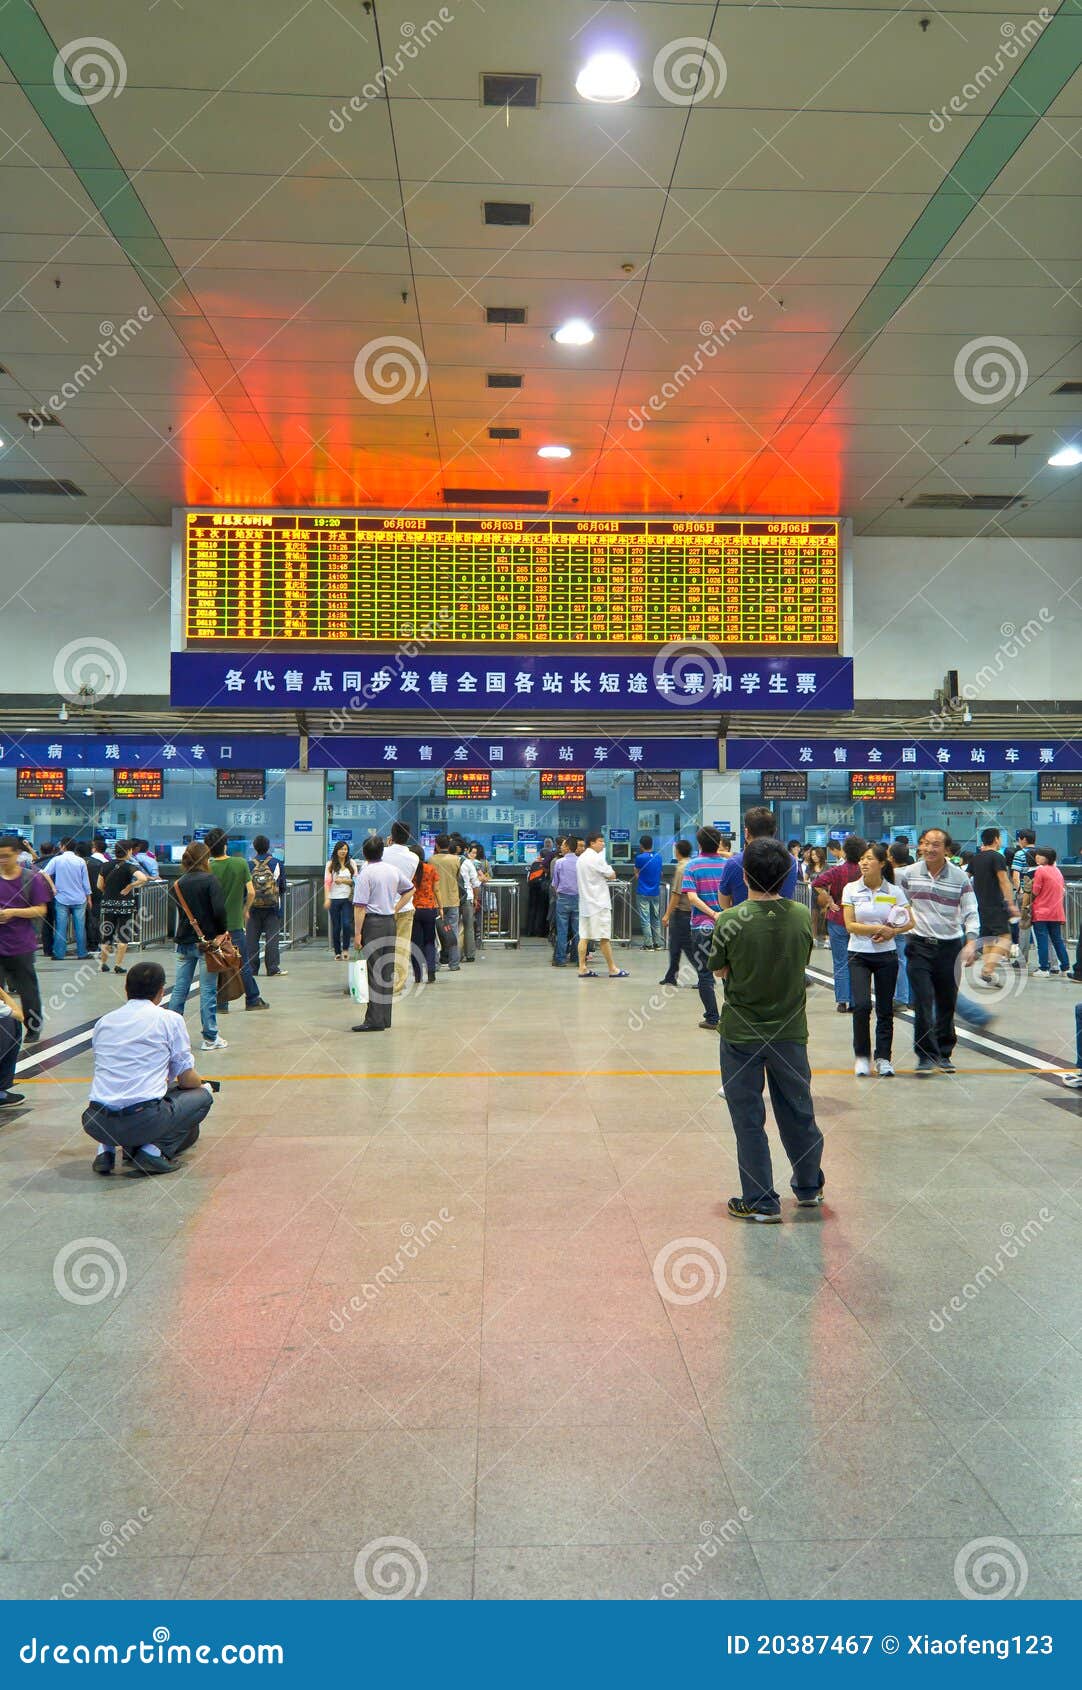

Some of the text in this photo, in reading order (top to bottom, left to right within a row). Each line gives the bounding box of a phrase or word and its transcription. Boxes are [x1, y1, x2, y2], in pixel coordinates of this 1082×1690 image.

[384, 520, 427, 530] 06月02日
[481, 521, 523, 530] 06月03日
[577, 522, 619, 532] 06月04日
[673, 523, 714, 533] 06月05日
[768, 524, 810, 533] 06月06日
[224, 670, 817, 694] 各代售点同步发售全国各站长短途车票和学生票
[384, 745, 644, 762] 发售全国各站车票
[799, 747, 1054, 763] 发售全国各站车票
[118, 771, 128, 780] 16
[447, 773, 458, 781] 21
[542, 774, 553, 782] 22
